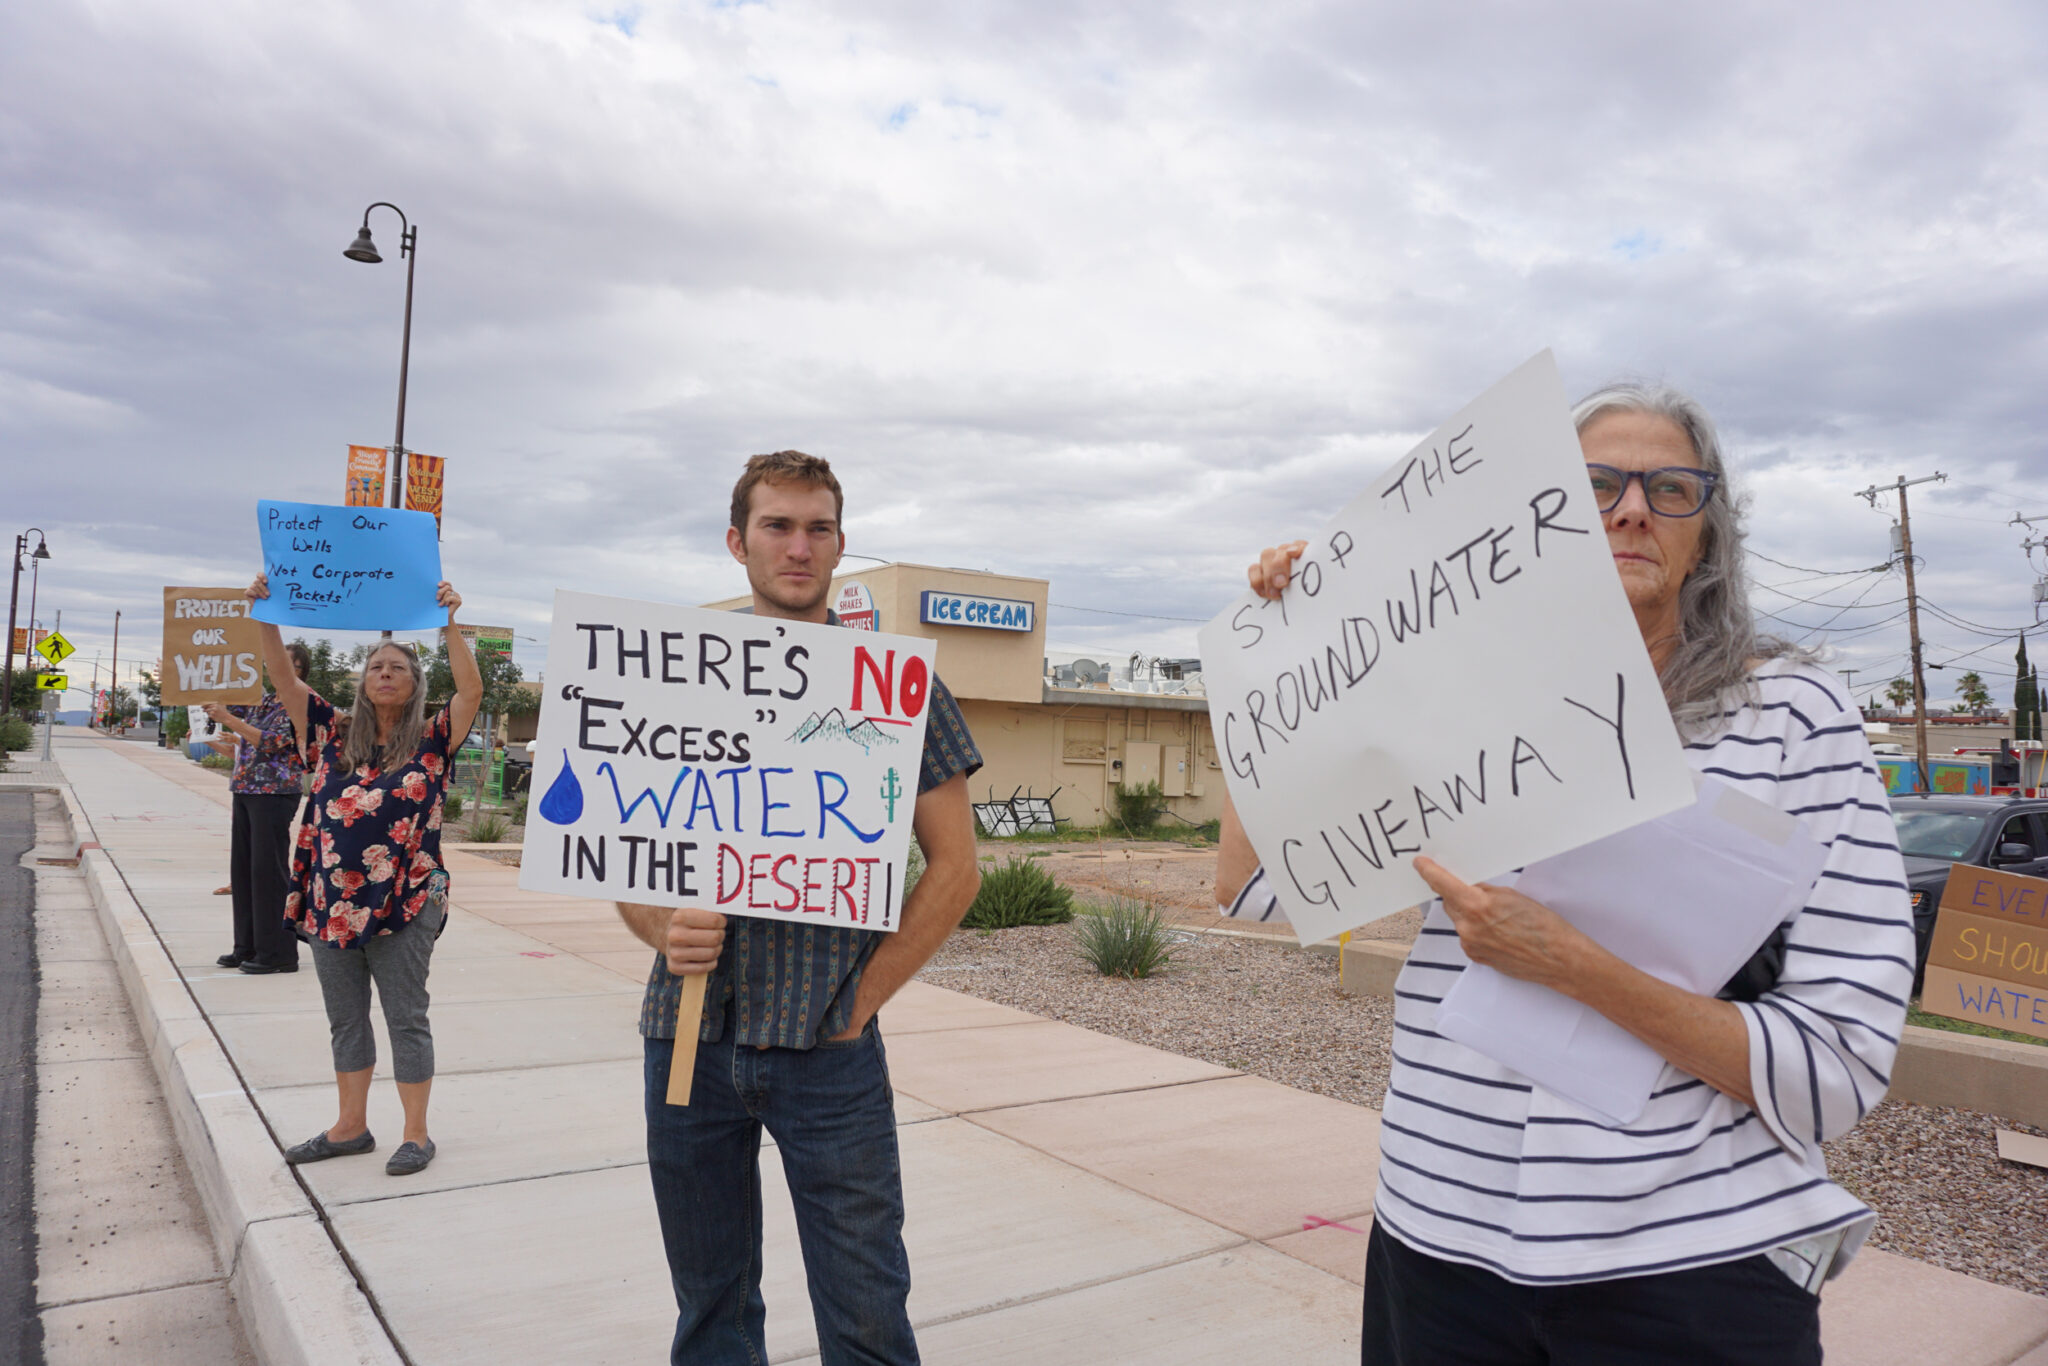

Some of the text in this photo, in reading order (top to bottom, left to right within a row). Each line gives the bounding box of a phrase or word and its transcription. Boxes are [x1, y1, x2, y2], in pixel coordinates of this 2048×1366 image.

[411, 485, 440, 496] WEST
[416, 495, 437, 504] END
[269, 508, 388, 530] Protect Our
[292, 537, 332, 553] Wells
[1232, 424, 1483, 649] STOP THE
[268, 564, 395, 587] Not Corporate
[844, 586, 859, 597] MILK
[174, 598, 251, 619] PROTECT
[840, 598, 863, 611] SHAKES
[932, 597, 1027, 627] ICE CREAM
[843, 617, 872, 631] OTHIES
[192, 628, 228, 645] OUR
[1225, 488, 1589, 788] GROUNDWATER
[174, 652, 258, 691] WELLS
[576, 623, 928, 718] THERE'S NO
[596, 762, 884, 843] WATER
[1282, 672, 1635, 911] GIVEAWAY
[562, 833, 892, 926] IN THE DESERT!
